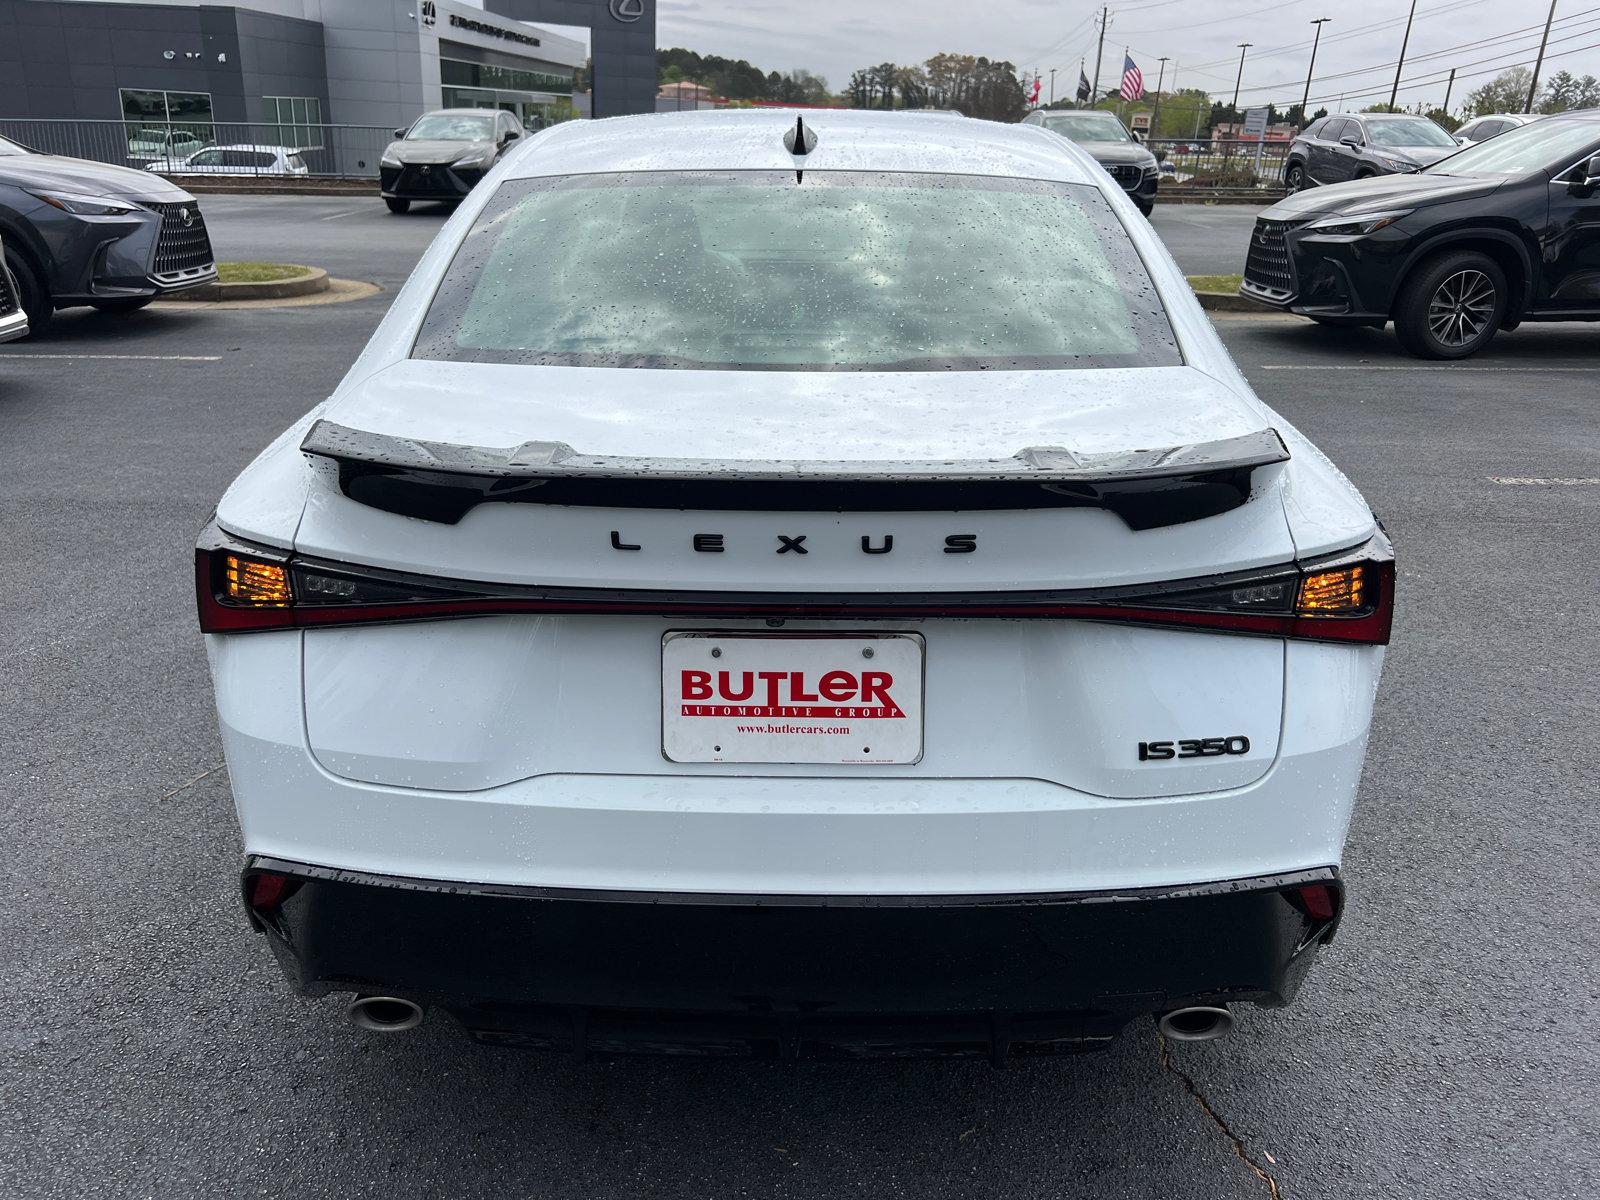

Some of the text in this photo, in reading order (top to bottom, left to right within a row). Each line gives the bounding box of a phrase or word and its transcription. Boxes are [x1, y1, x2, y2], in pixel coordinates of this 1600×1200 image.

[610, 531, 977, 554] LEXUS
[682, 706, 898, 718] AUTOMOTIVE GROUP
[737, 724, 850, 735] www.butlercars.com
